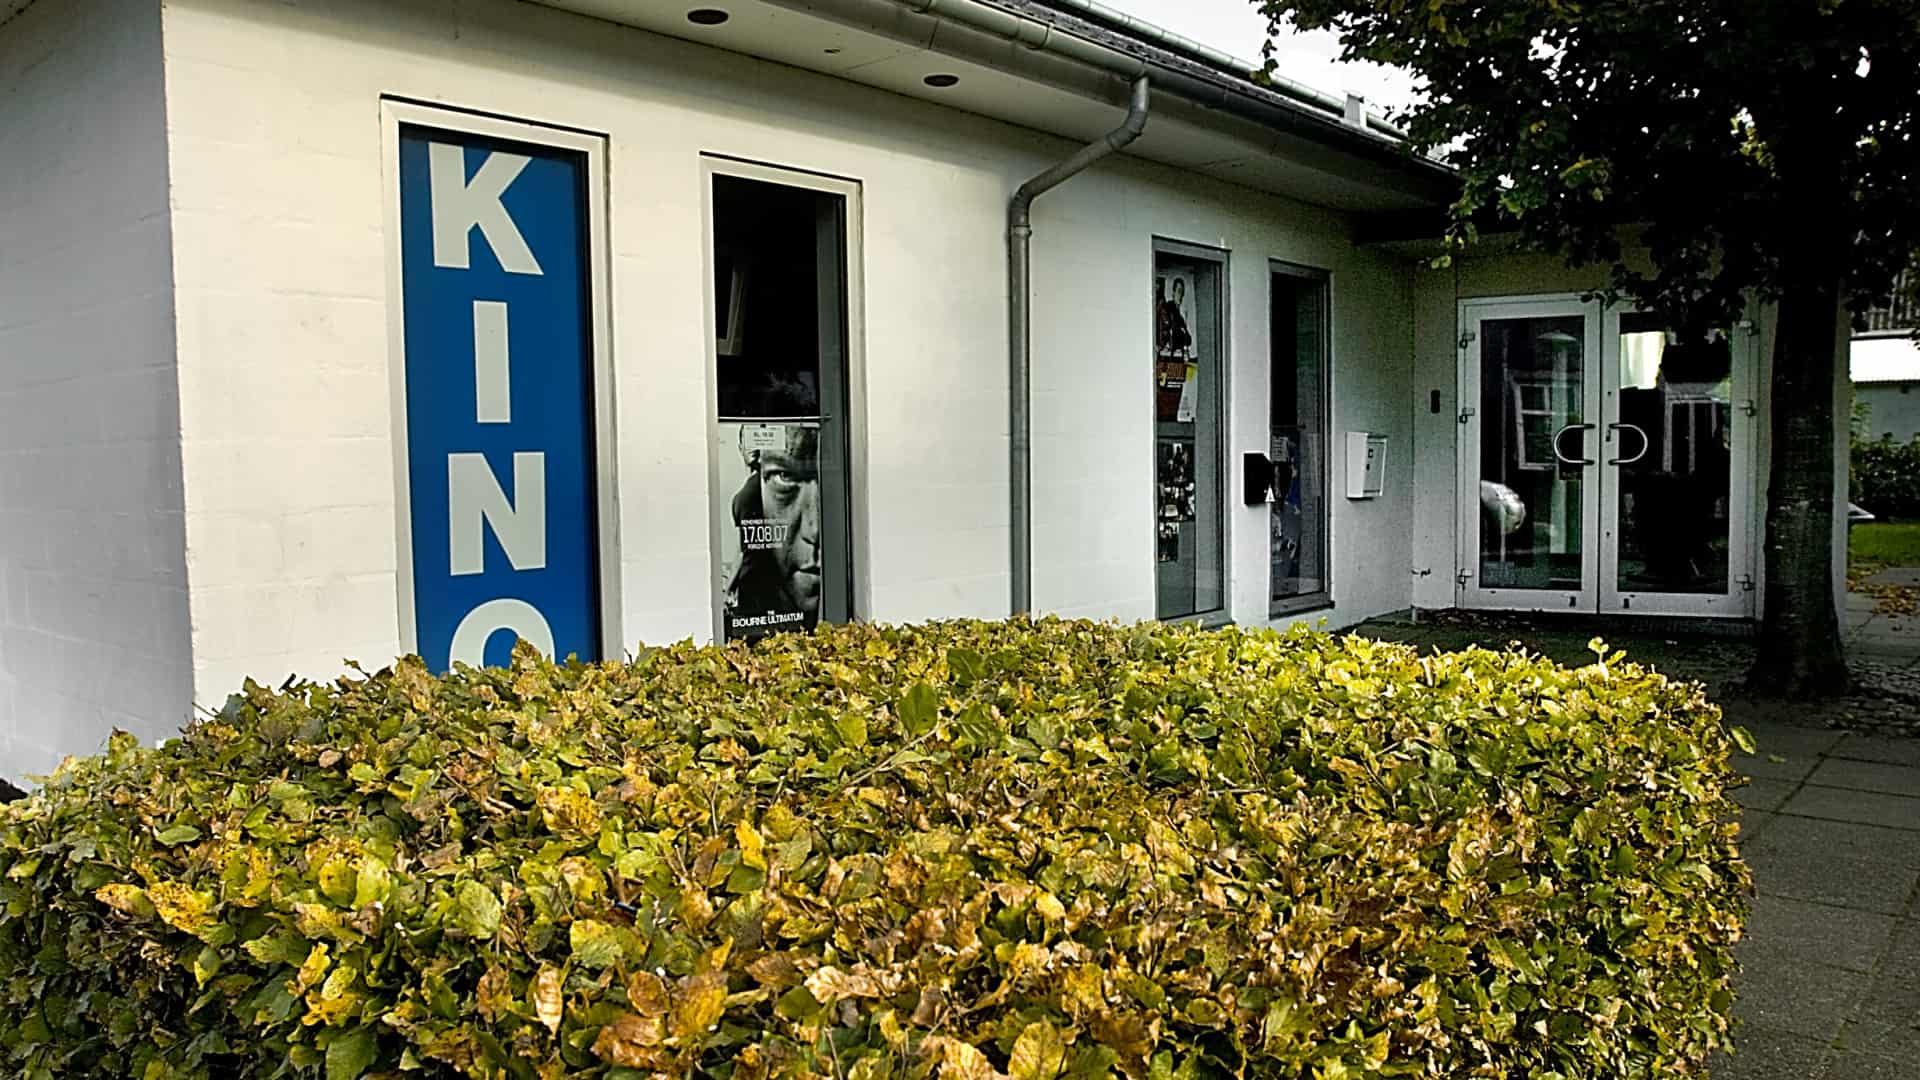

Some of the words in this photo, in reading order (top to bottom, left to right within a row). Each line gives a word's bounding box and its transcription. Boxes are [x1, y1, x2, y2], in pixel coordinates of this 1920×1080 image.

[428, 141, 557, 674] KINO
[742, 525, 788, 543] 17.08.07
[732, 616, 767, 628] BOURNE
[767, 611, 804, 625] ULTIMATUM
